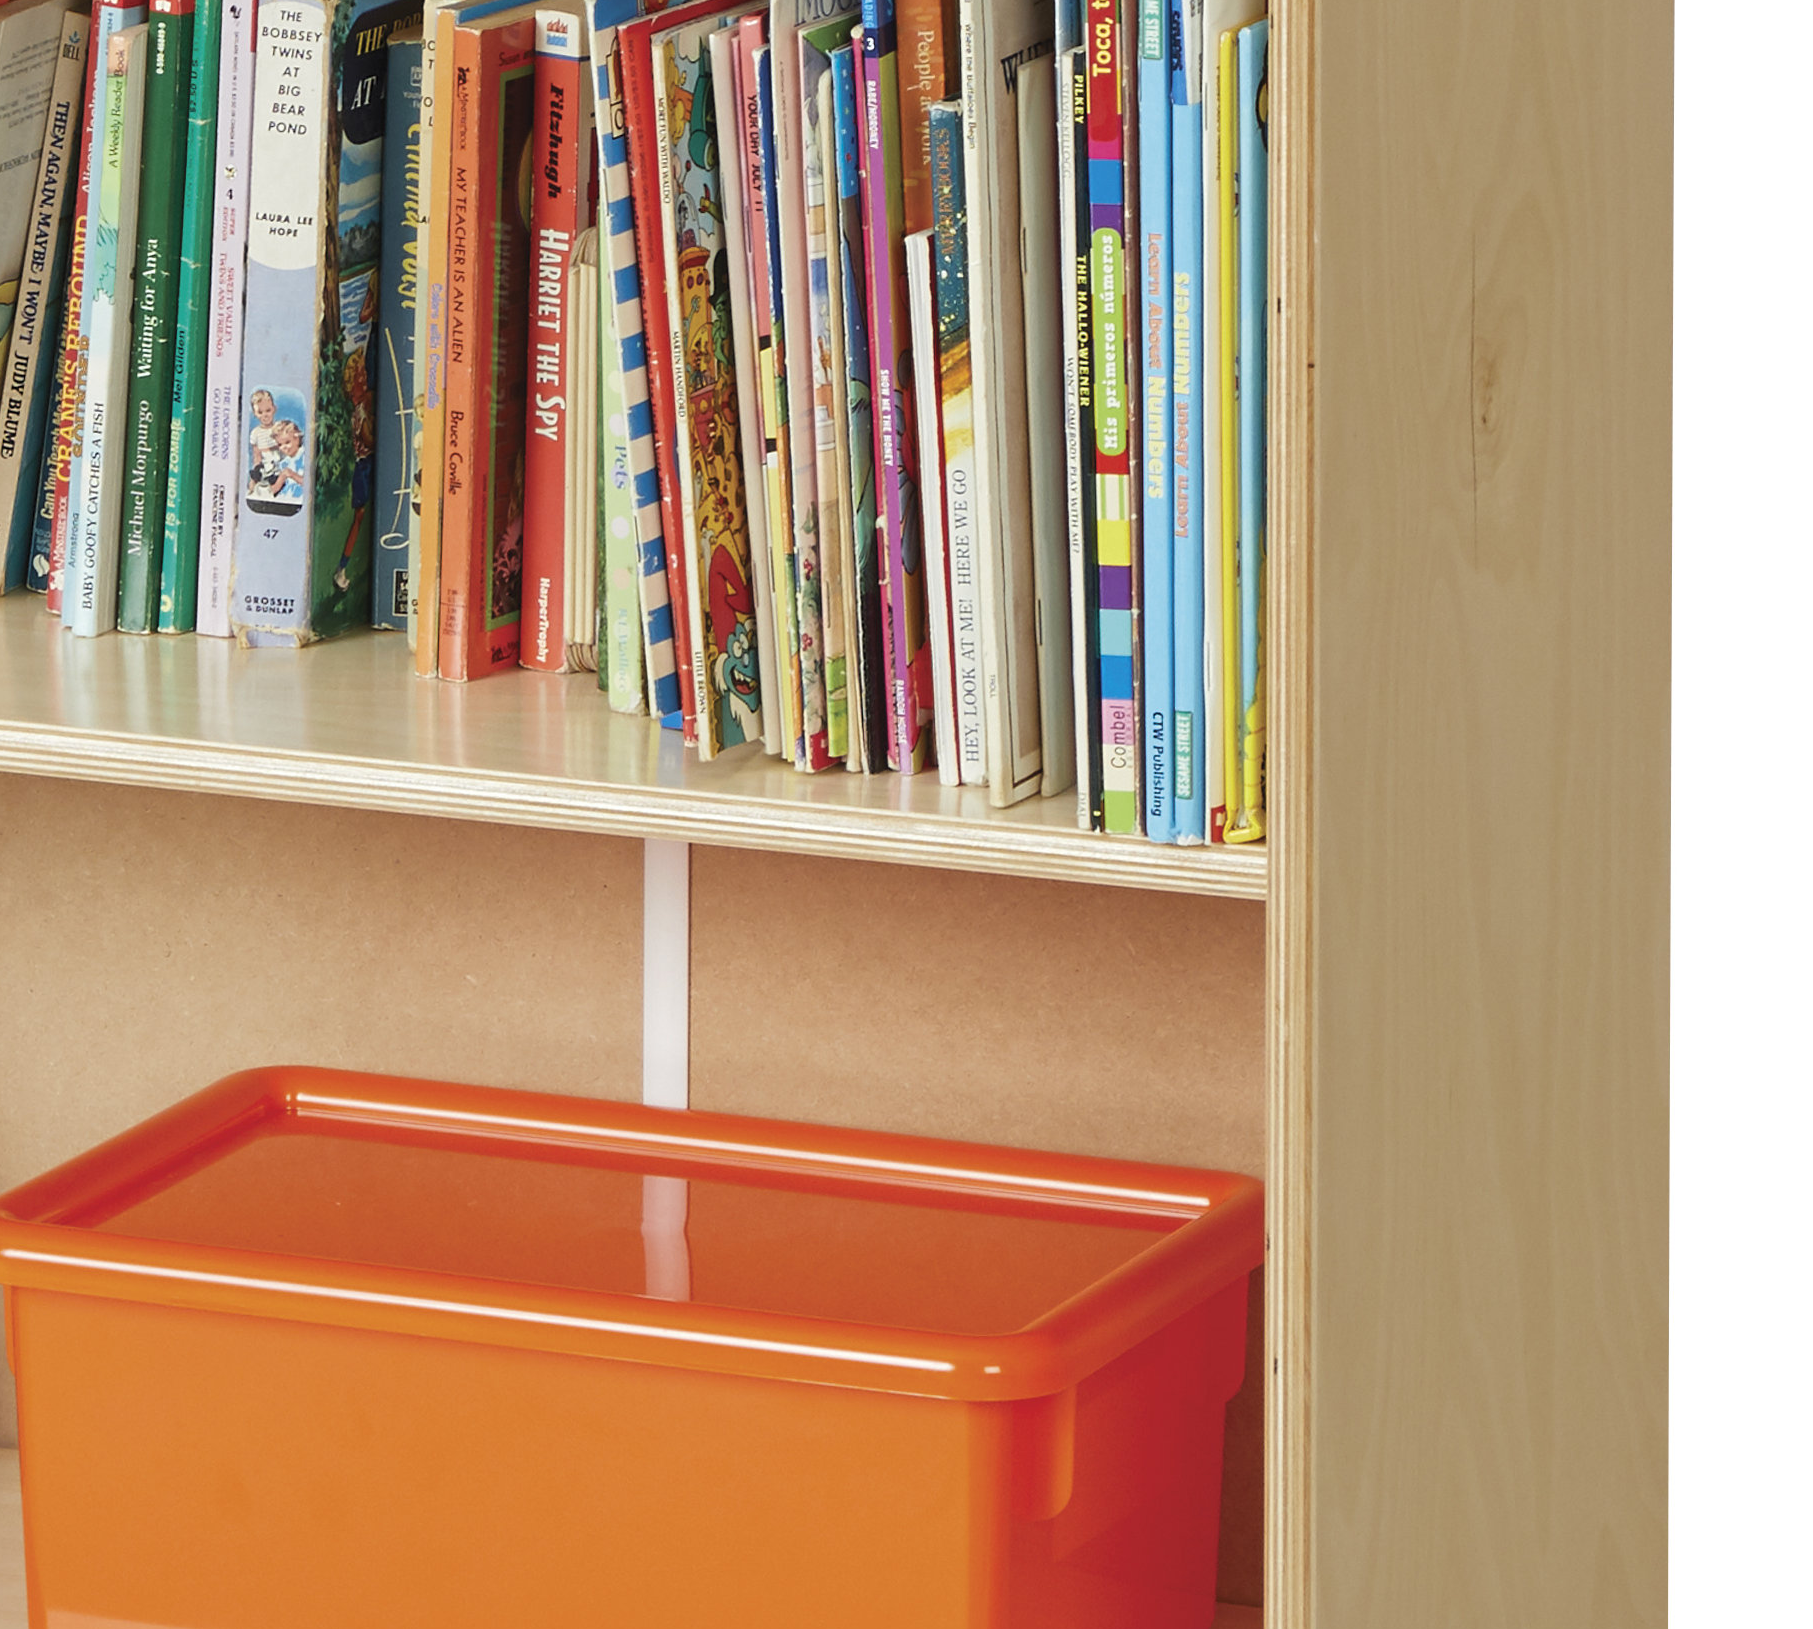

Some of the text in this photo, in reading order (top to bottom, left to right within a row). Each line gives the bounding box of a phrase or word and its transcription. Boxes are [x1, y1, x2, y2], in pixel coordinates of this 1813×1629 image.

[279, 10, 302, 23] THE
[262, 27, 322, 43] BOBBSEY
[271, 47, 313, 60] TWINS
[1092, 18, 1114, 77] Toca,
[283, 66, 300, 78] AT
[278, 84, 301, 97] BIG
[272, 102, 305, 116] BEAR
[268, 122, 307, 136] POND
[546, 83, 564, 198] Fitzhugh
[255, 212, 313, 226] LAURA LEE
[269, 226, 298, 237] HOPE
[539, 230, 569, 332] HARRIET
[137, 238, 162, 379] Waiting for Anya
[536, 343, 560, 386] THE
[127, 400, 154, 555] Michael Morpurgo
[263, 528, 279, 539] 47
[535, 578, 550, 663] HarperTrophy
